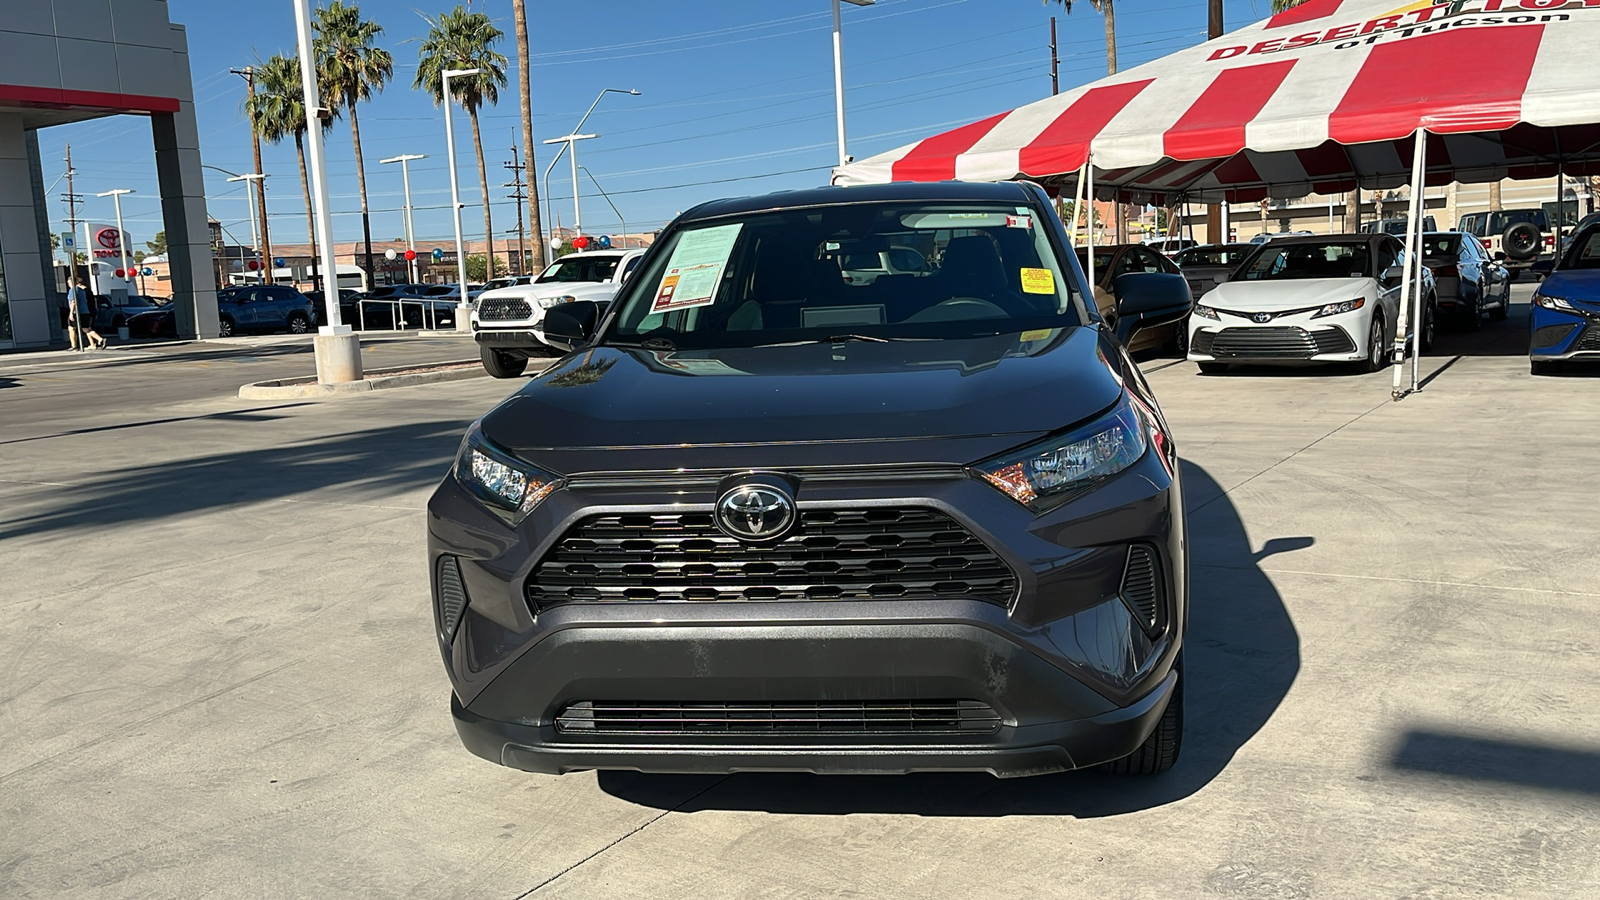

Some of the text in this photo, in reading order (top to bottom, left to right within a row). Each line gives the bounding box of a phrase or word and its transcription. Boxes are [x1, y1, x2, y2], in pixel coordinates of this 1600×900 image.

[1206, 2, 1450, 61] DESERT
[1334, 14, 1570, 50] of Tucson
[93, 249, 132, 258] TOYOA
